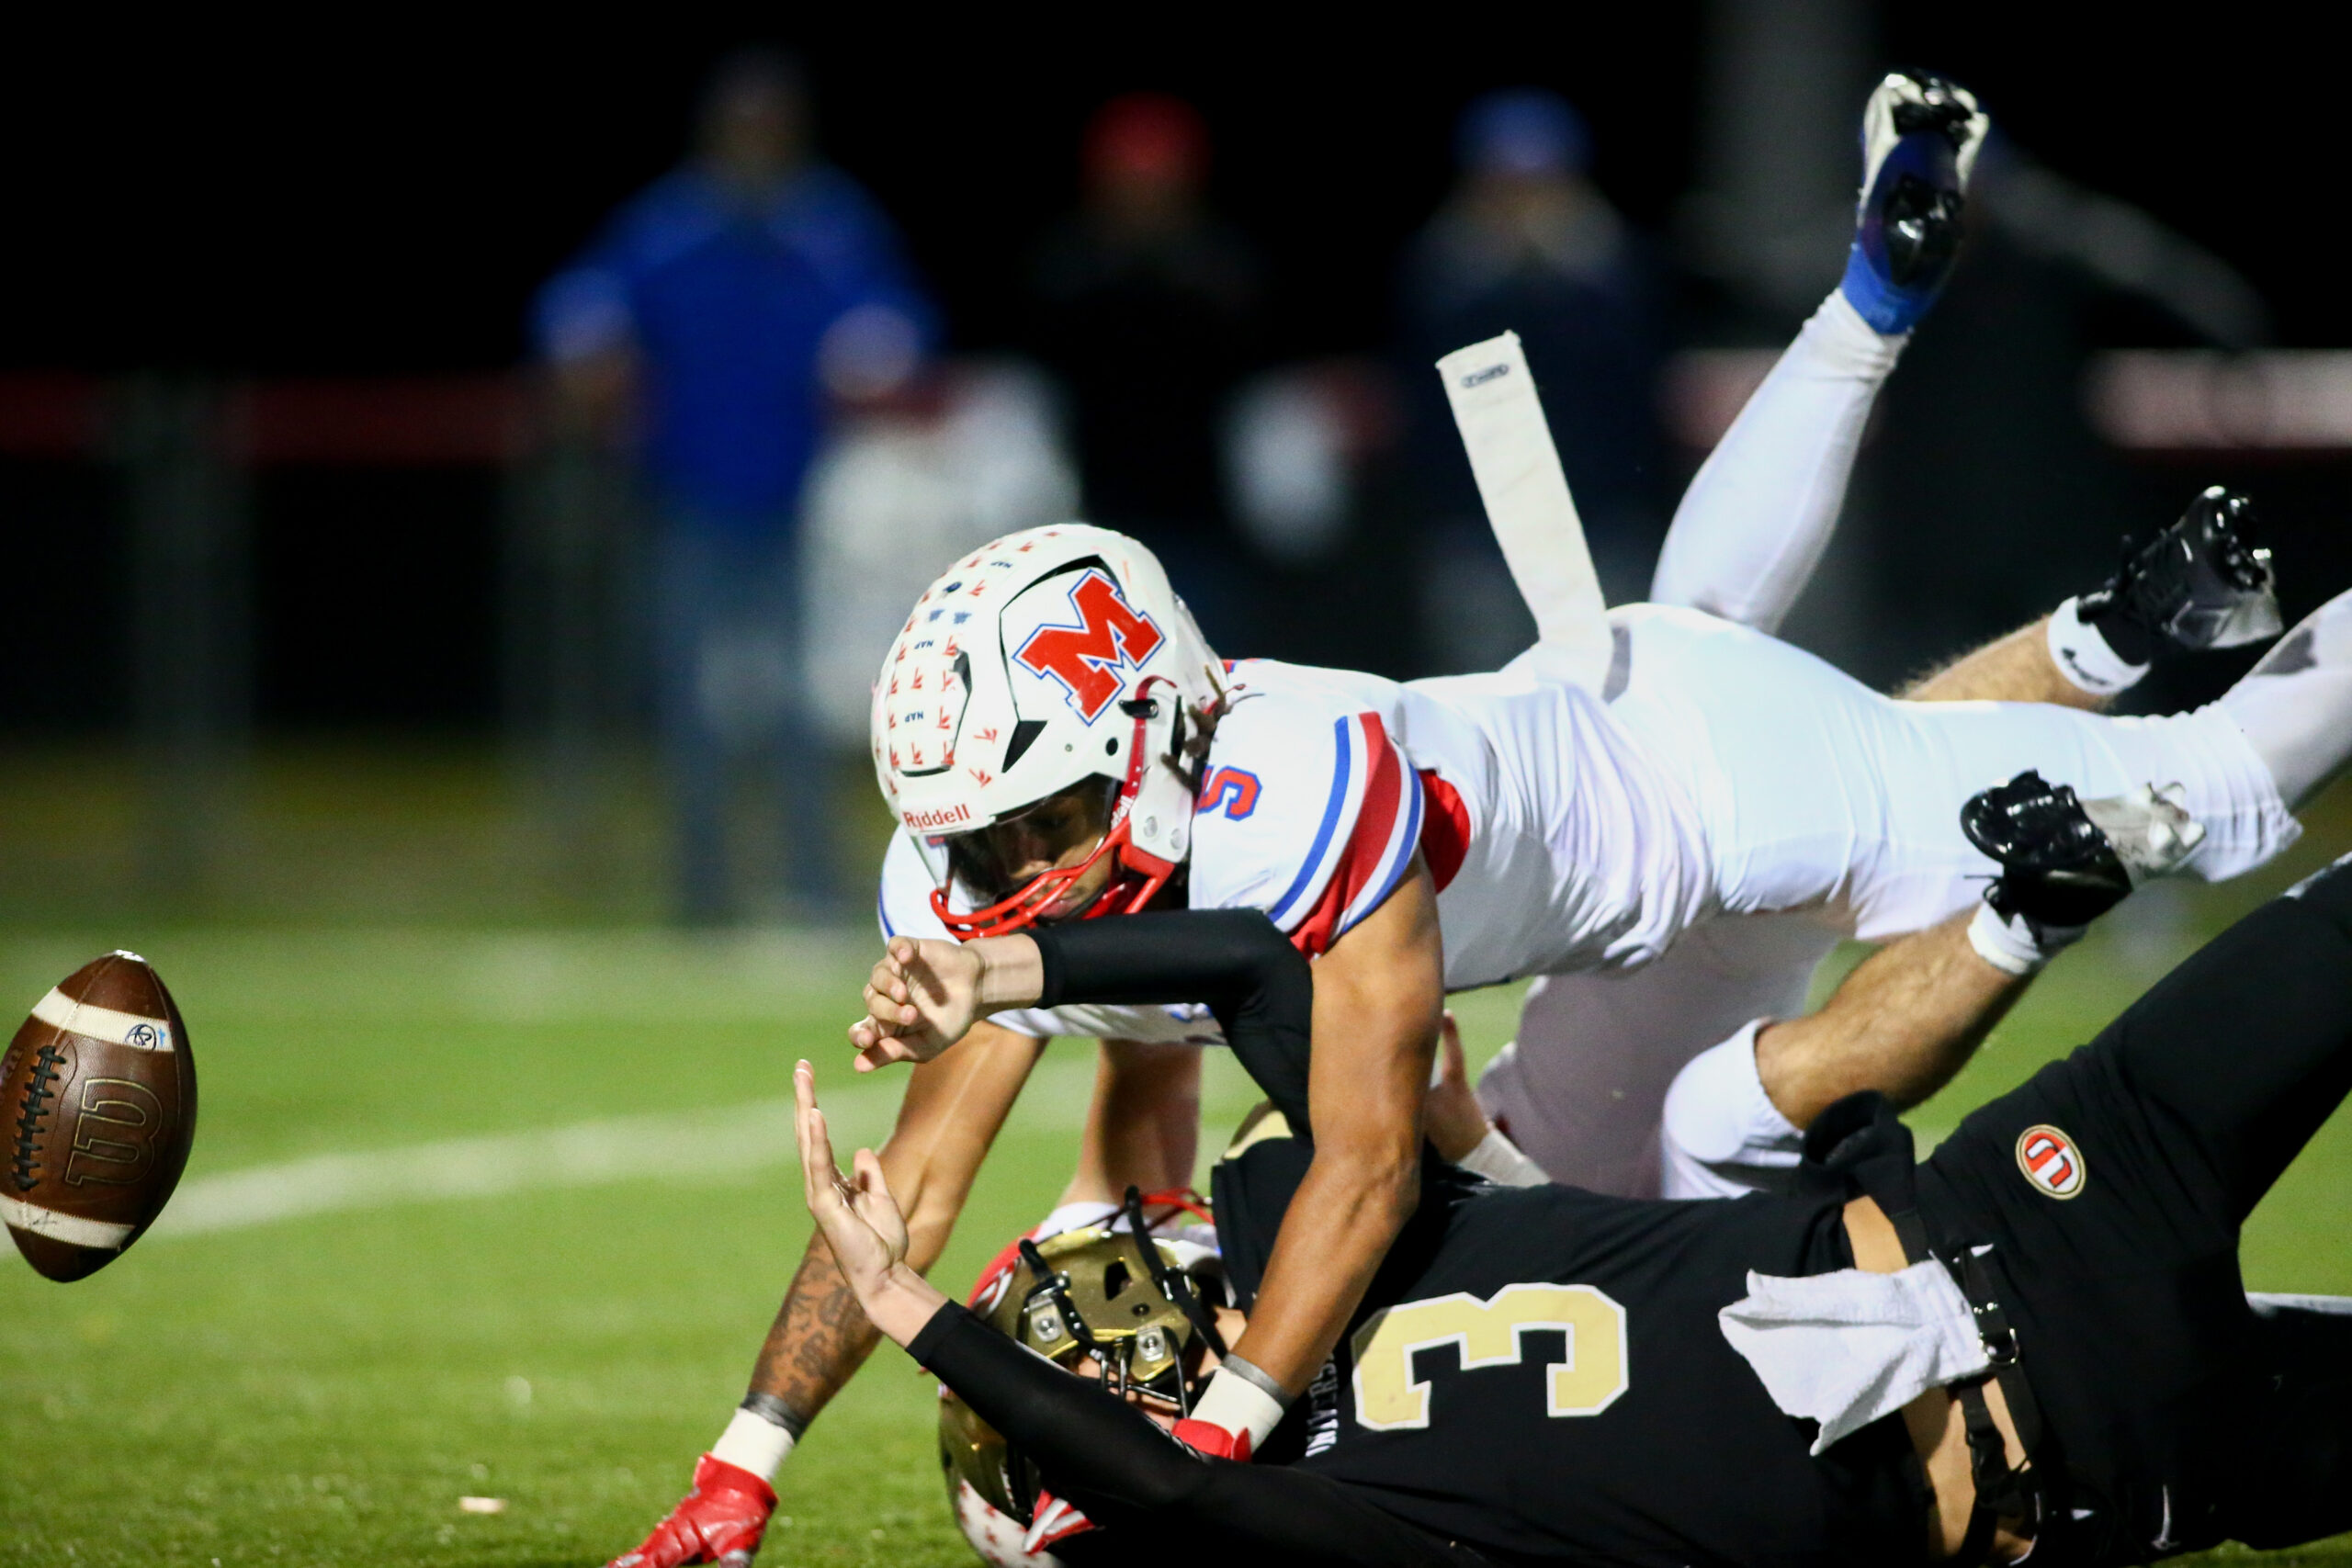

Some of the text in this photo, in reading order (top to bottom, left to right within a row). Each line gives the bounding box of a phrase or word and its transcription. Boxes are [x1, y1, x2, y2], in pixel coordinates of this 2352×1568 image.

[1012, 569, 1166, 727] M
[904, 710, 924, 723] NAP
[903, 804, 970, 828] Riddell
[1195, 764, 1262, 822] 5
[65, 1078, 164, 1186] W
[1351, 1282, 1630, 1431] 3
